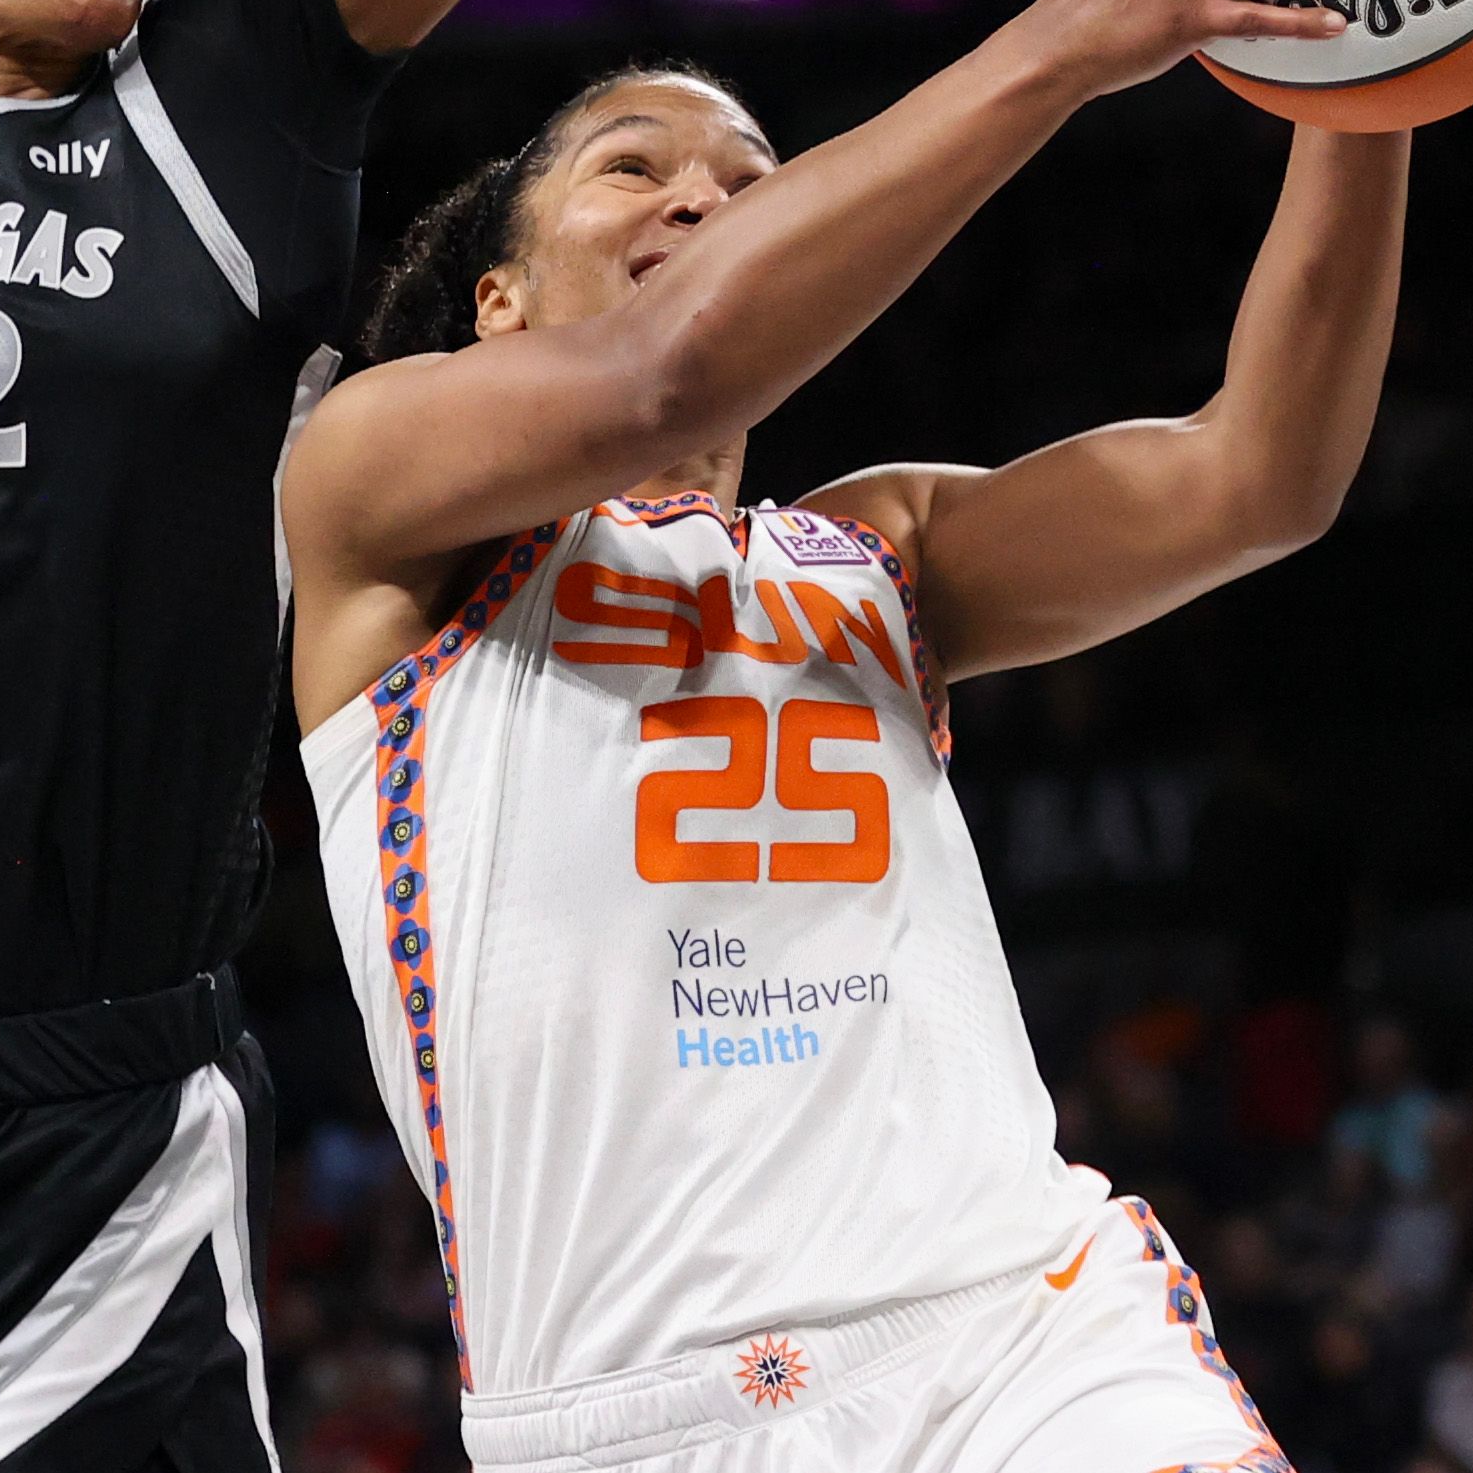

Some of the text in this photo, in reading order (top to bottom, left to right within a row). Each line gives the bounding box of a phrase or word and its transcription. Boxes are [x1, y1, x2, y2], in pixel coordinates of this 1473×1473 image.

[29, 138, 111, 178] ally
[784, 535, 852, 551] Post
[552, 561, 907, 690] SUN
[635, 695, 891, 884] 25
[667, 928, 747, 969] Yale
[672, 973, 888, 1019] NewHaven
[677, 1023, 820, 1068] Health
